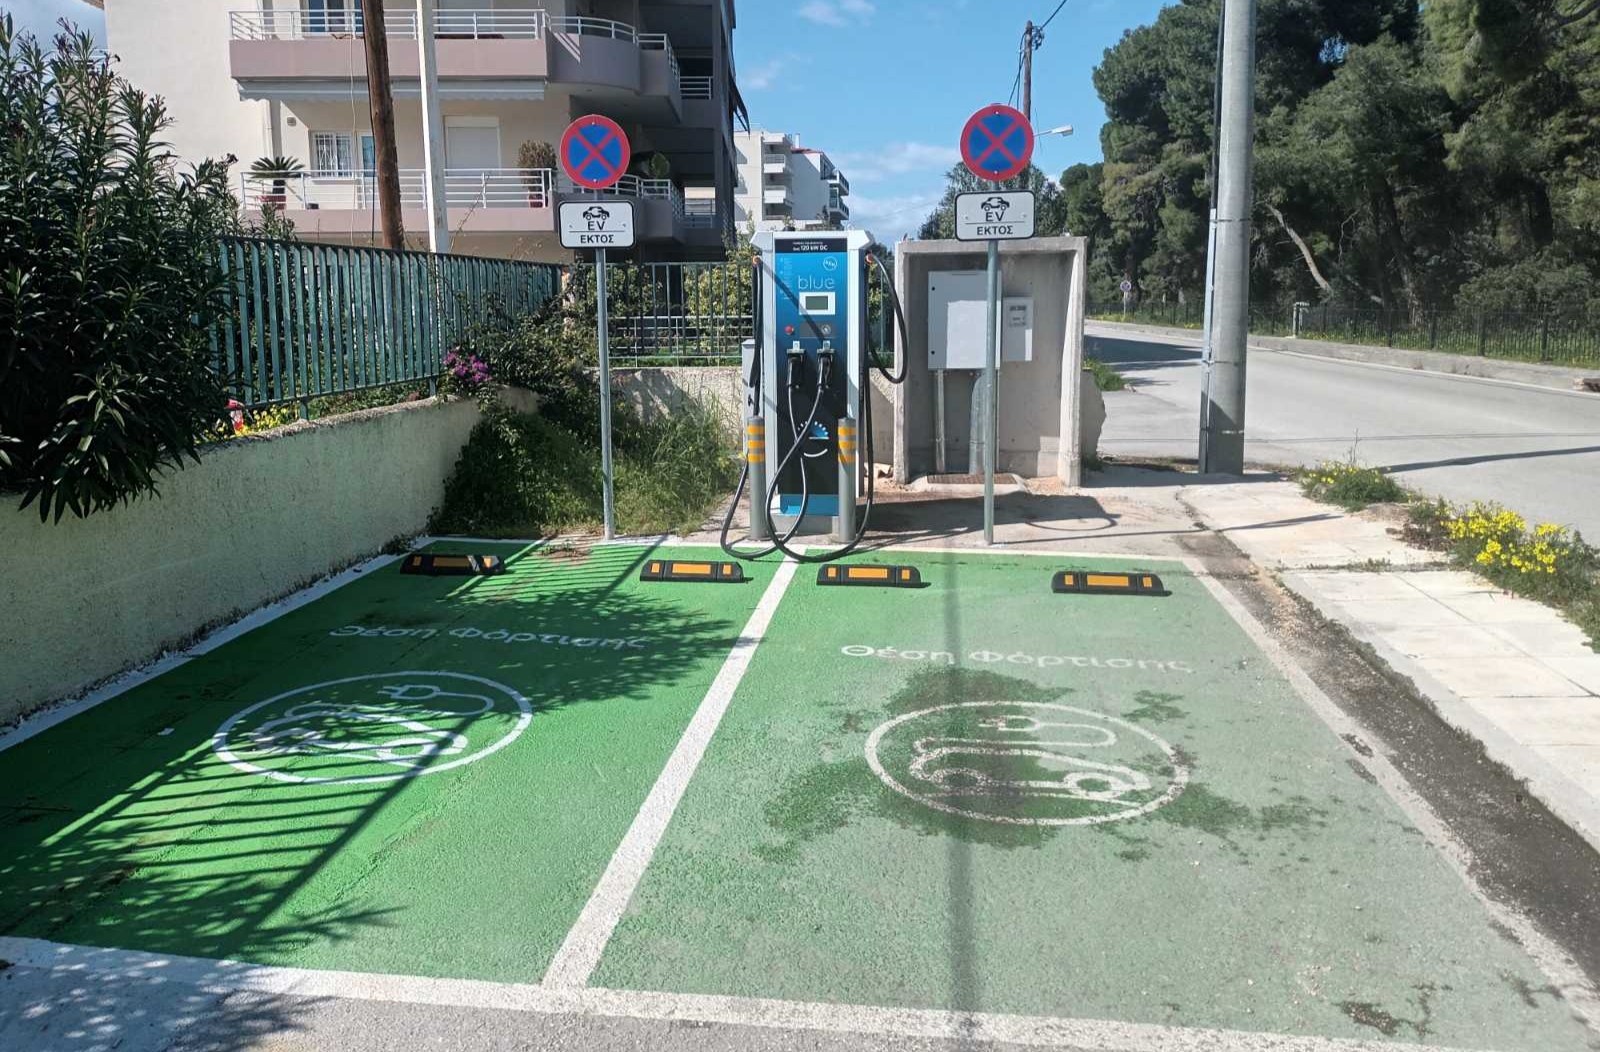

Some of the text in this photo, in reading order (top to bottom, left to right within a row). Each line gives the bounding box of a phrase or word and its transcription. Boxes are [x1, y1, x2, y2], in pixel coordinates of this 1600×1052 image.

[985, 211, 1005, 222] EV
[587, 220, 606, 231] EV
[976, 225, 1014, 236] ΕΚΤΟΣ
[580, 234, 615, 244] ΕΚΤΟΣ
[798, 275, 835, 290] blue
[841, 644, 1193, 674] Θέση Φόρτισης
